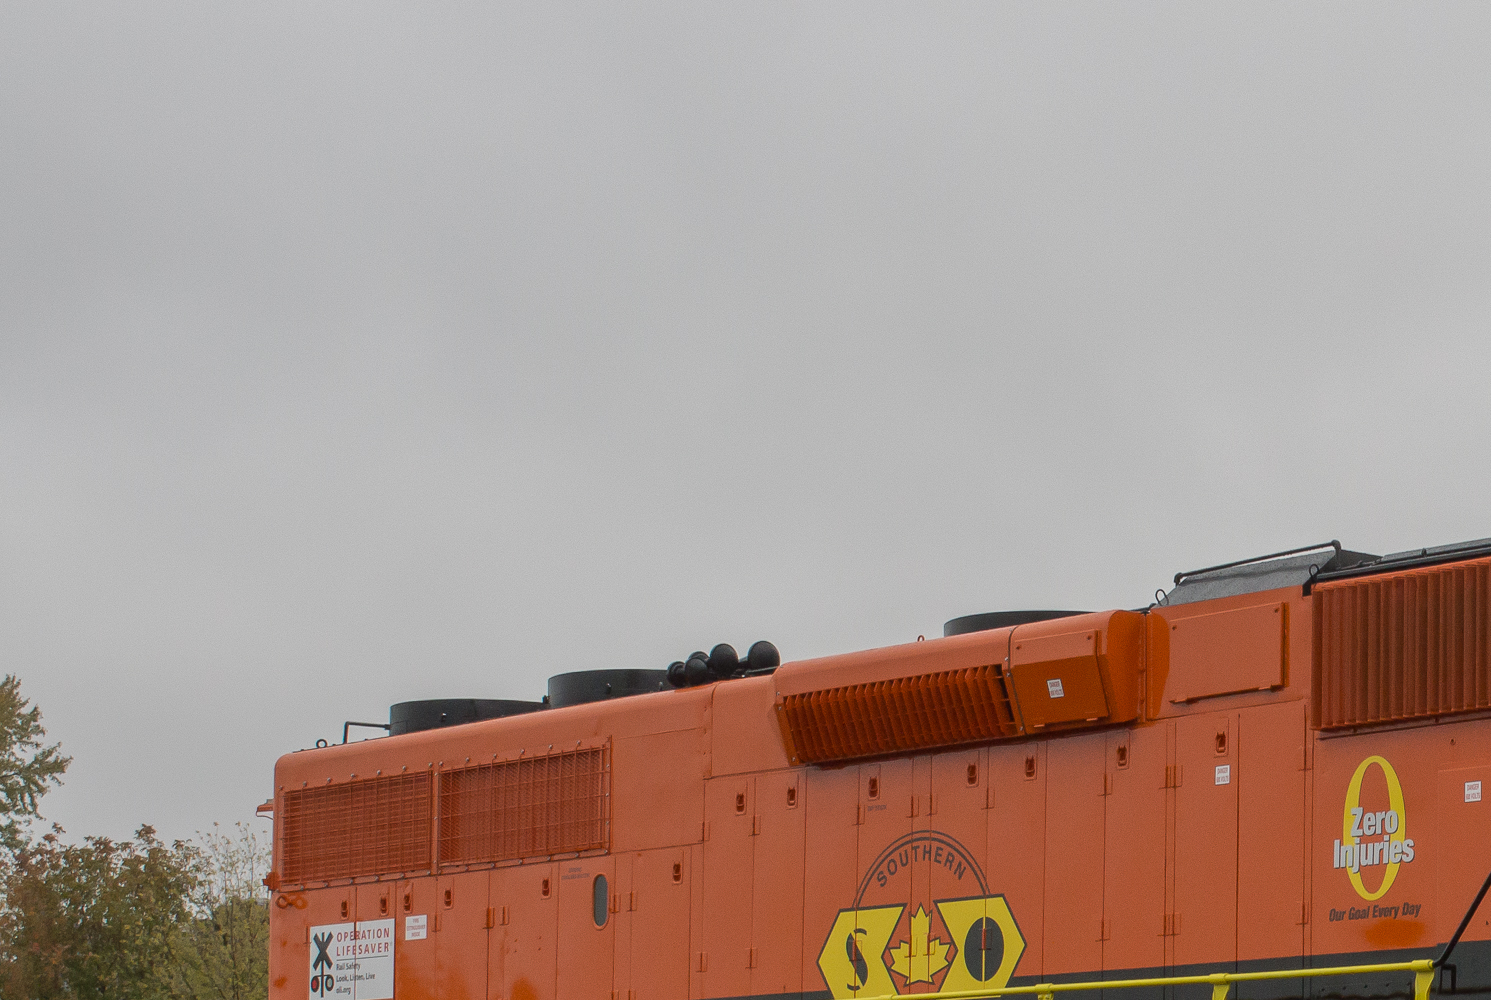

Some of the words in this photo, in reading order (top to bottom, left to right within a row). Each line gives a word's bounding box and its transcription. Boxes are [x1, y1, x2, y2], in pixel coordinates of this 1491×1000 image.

[1350, 806, 1399, 837] Zero
[1333, 834, 1415, 874] Injuries
[876, 844, 967, 888] SOUTHERN
[1329, 908, 1347, 922] Our
[1348, 905, 1370, 921] Goal
[1372, 904, 1400, 920] Every
[1402, 902, 1422, 918] Day
[336, 927, 390, 943] OPERATION
[336, 941, 390, 957] LIFESAVER
[336, 963, 345, 971] Rail
[345, 962, 361, 971] Safety
[845, 928, 869, 991] S
[365, 972, 376, 980] Live
